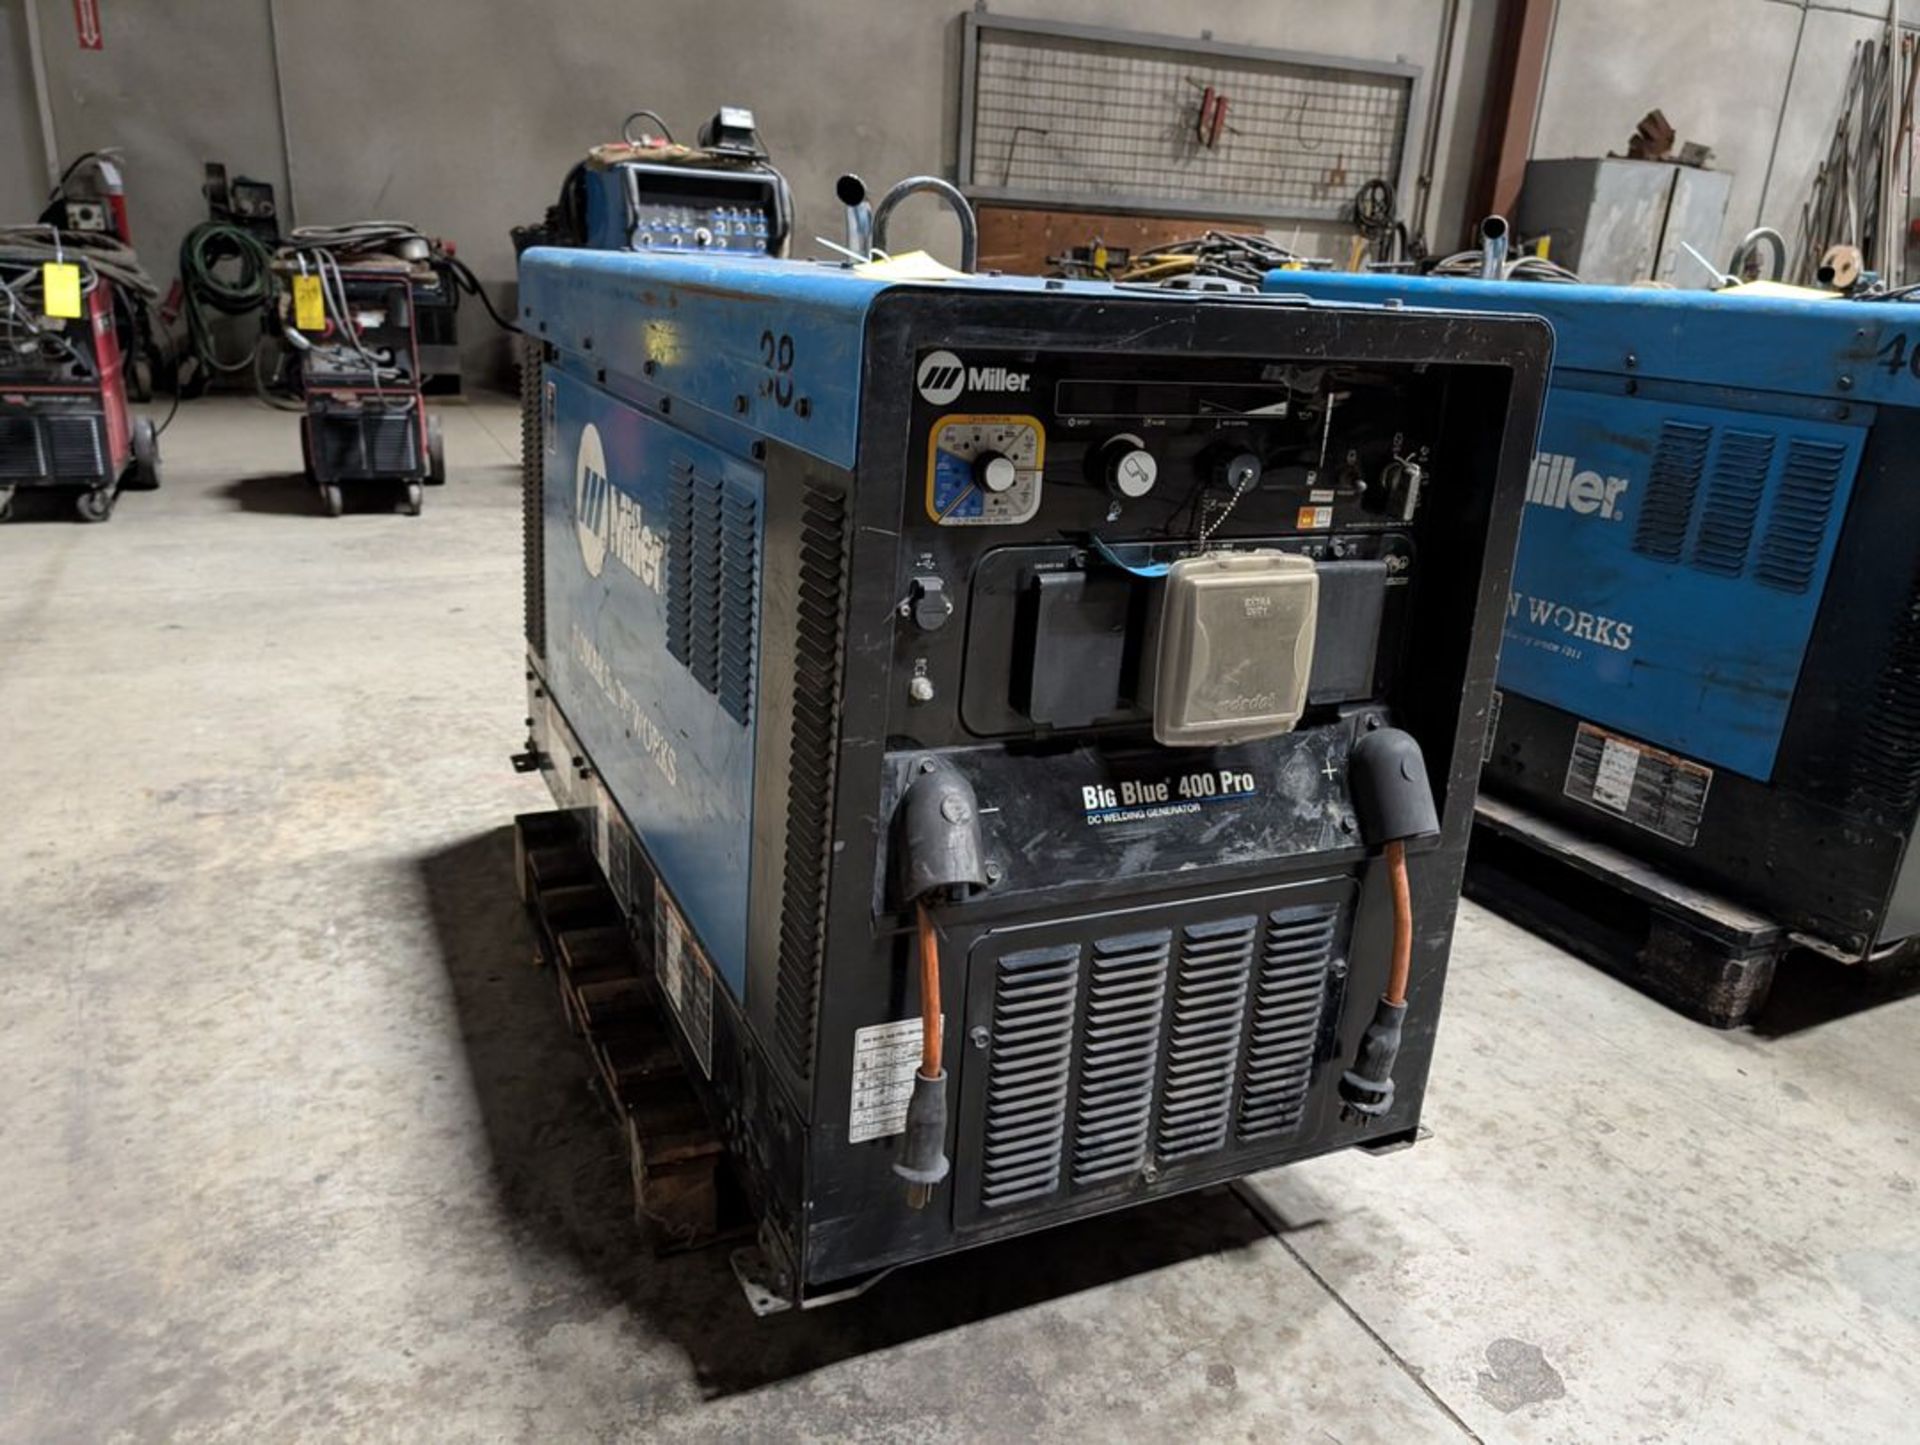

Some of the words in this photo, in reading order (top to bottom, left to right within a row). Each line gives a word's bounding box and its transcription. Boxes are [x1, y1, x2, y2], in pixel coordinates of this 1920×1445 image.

[967, 367, 1030, 392] Miller
[609, 484, 665, 595] Miller
[1528, 596, 1633, 651] WORKS
[1120, 780, 1169, 806] Blue
[1178, 773, 1216, 799] 400
[1219, 770, 1255, 794] Pro
[1087, 814, 1102, 826] DC
[1102, 808, 1146, 823] WELDING
[1146, 802, 1201, 818] GENERATOR
